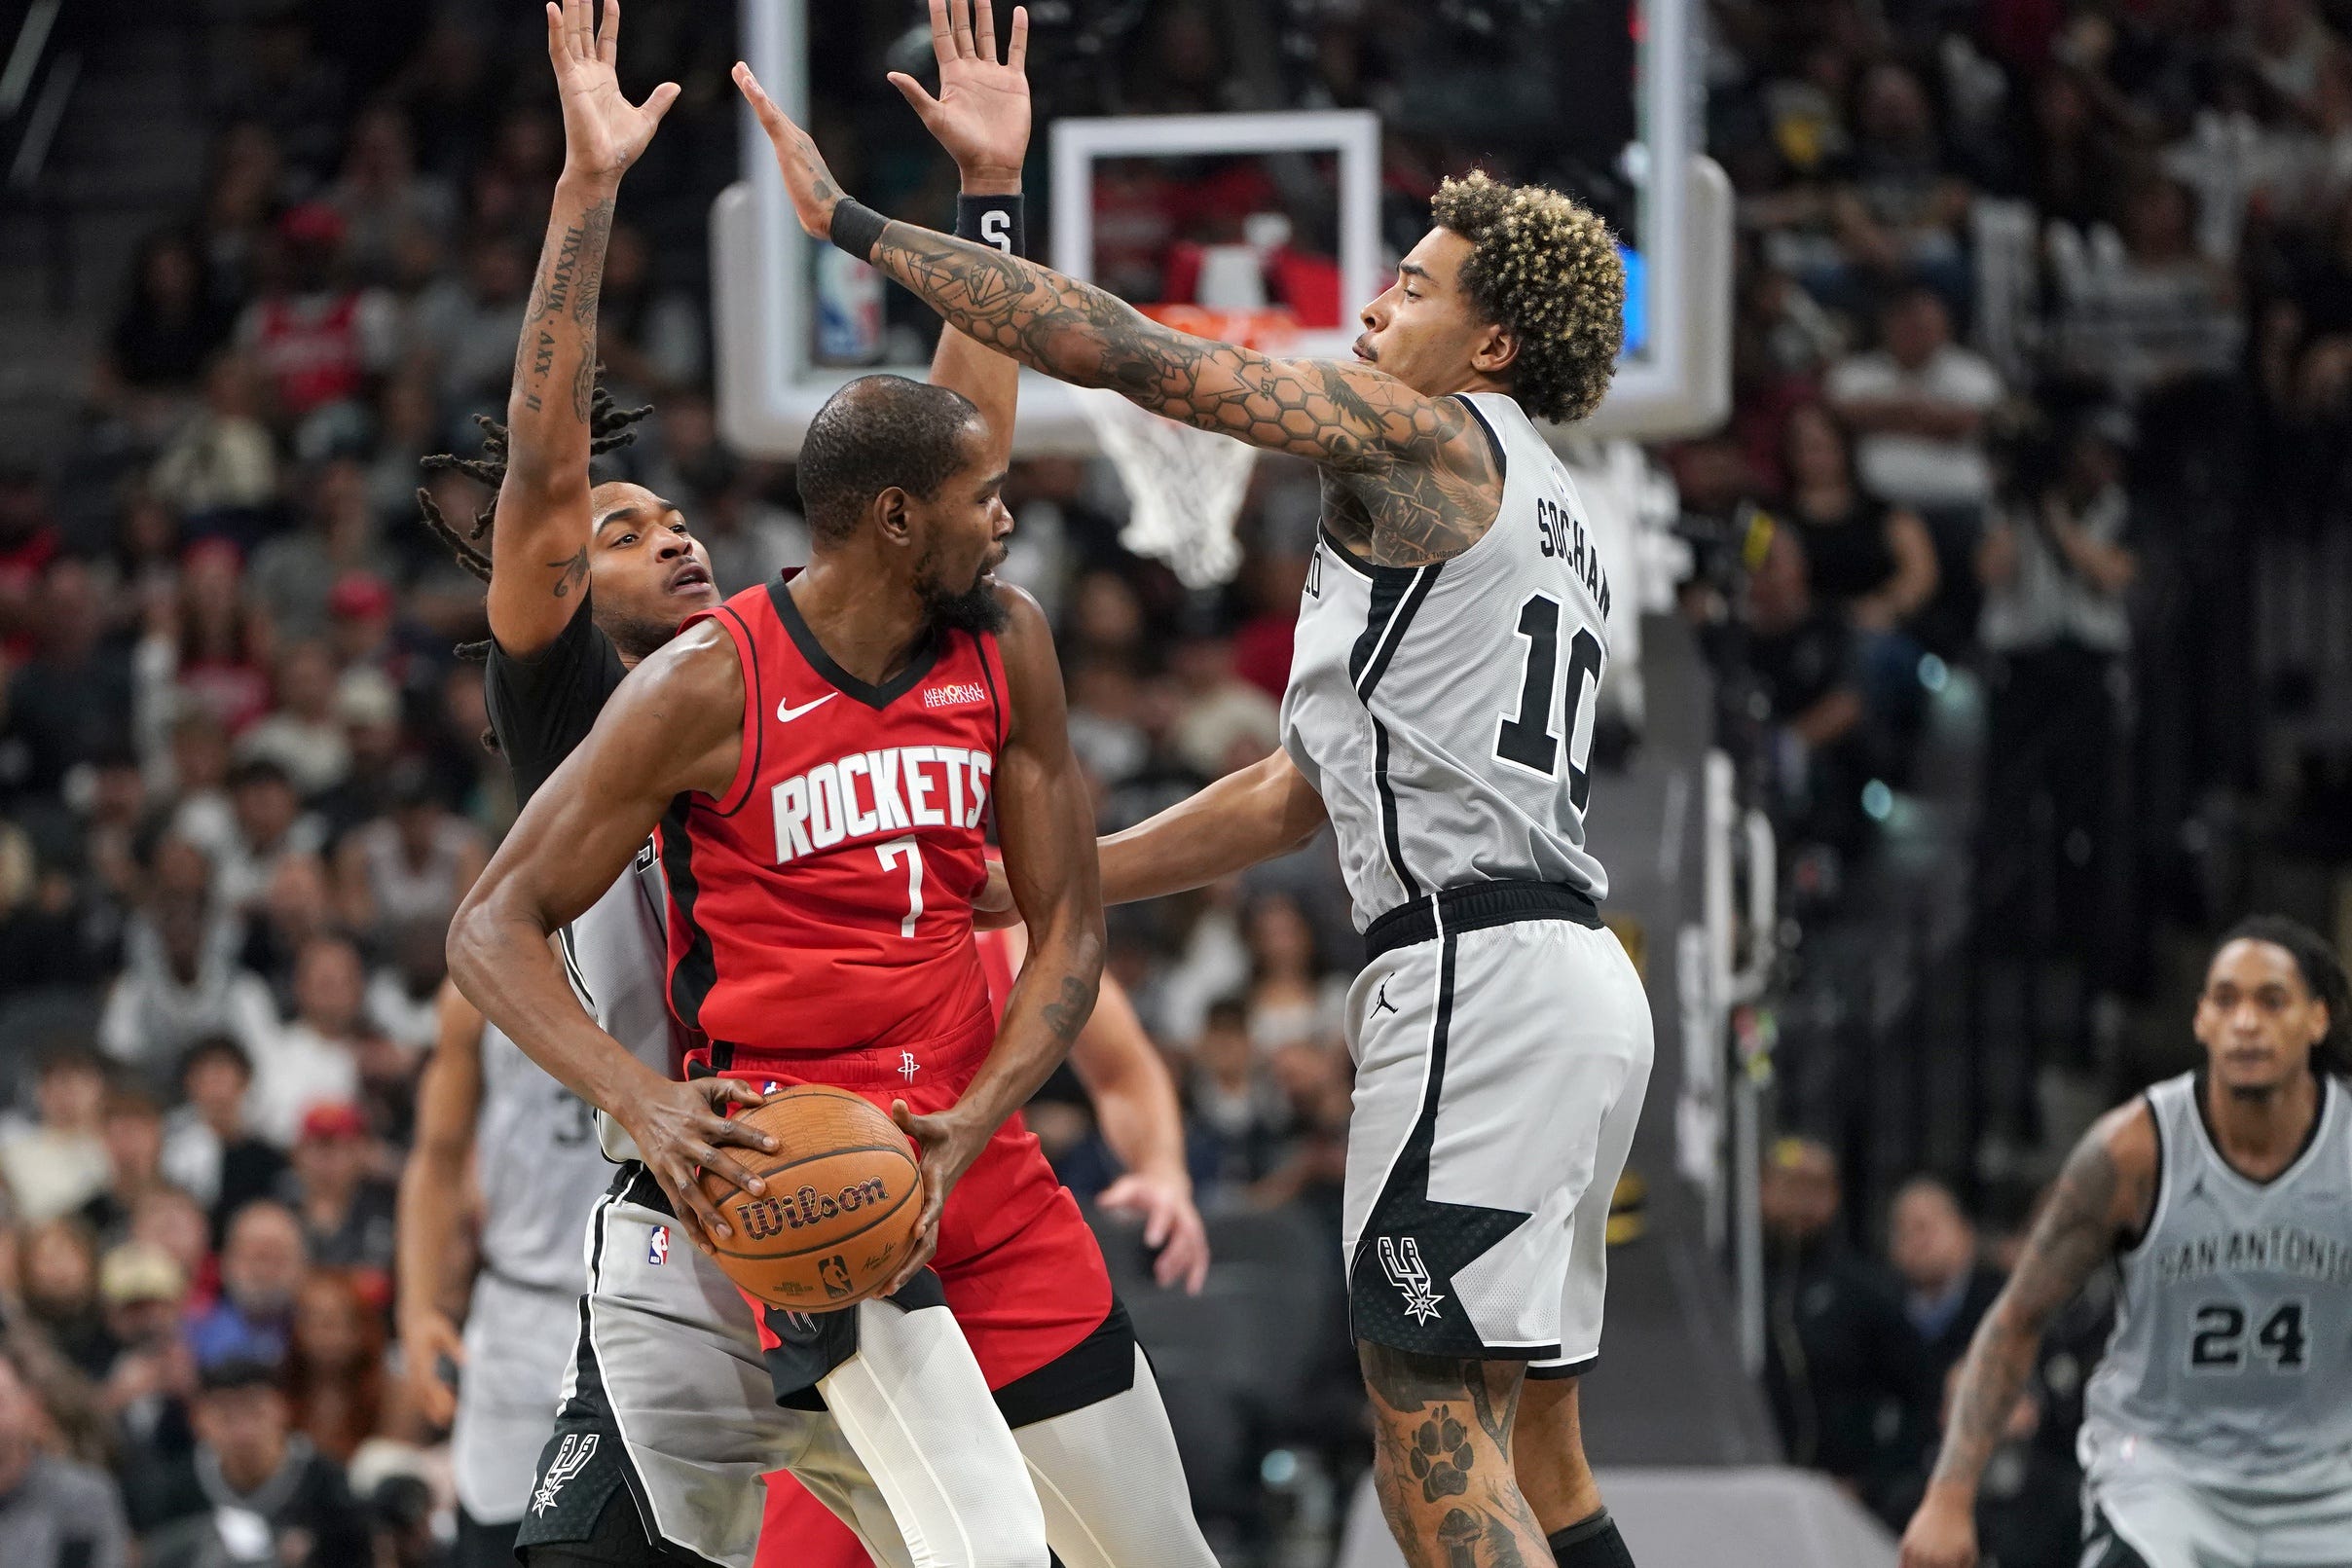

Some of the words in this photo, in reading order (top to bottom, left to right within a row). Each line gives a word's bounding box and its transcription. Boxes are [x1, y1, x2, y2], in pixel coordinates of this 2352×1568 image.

[981, 210, 1011, 254] S
[533, 330, 556, 379] XXV
[547, 225, 584, 313] MMXXII
[1537, 497, 1610, 623] SOCHAN
[923, 682, 984, 699] MEMORIAL
[926, 690, 985, 708] HERMANN
[1491, 589, 1606, 822] 10
[771, 746, 992, 864] ROCKETS
[874, 834, 924, 938] 7
[736, 1176, 889, 1241] Wilson
[2156, 1242, 2220, 1282] SAN
[2189, 1301, 2309, 1370] 24
